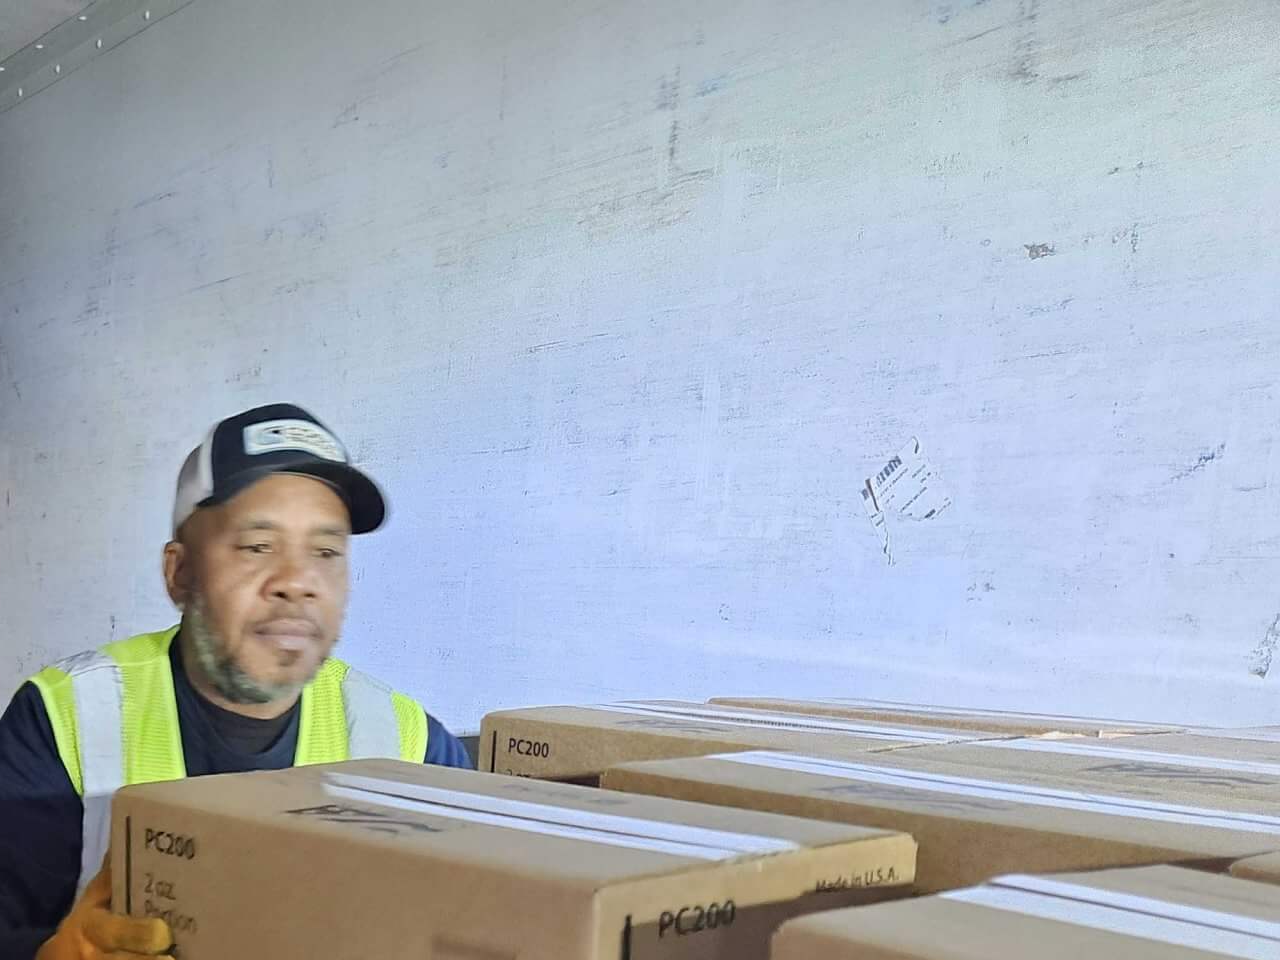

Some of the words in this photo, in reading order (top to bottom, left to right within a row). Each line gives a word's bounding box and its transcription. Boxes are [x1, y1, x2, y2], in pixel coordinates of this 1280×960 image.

[508, 737, 549, 758] PC200
[144, 828, 196, 860] PC200
[658, 900, 736, 938] PC200
